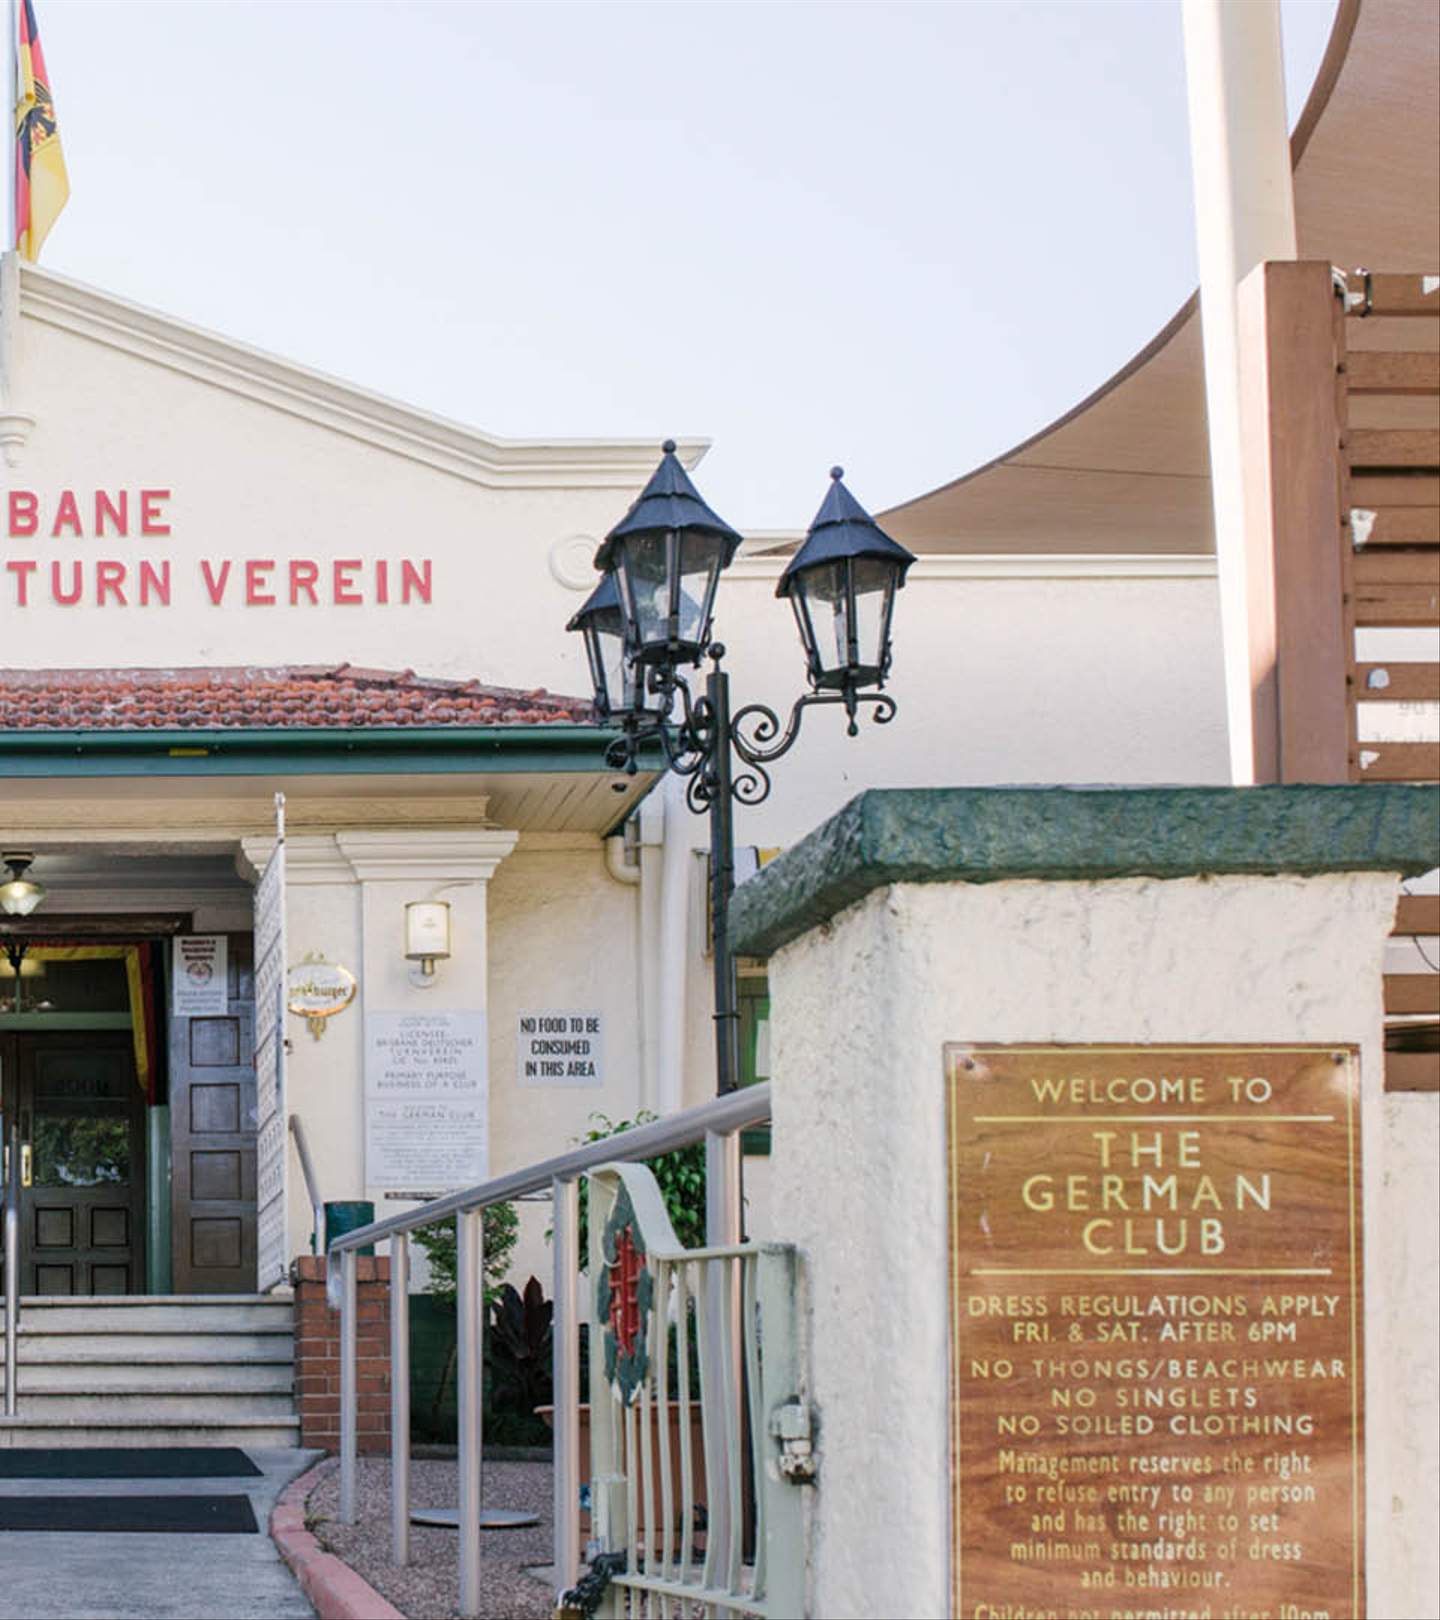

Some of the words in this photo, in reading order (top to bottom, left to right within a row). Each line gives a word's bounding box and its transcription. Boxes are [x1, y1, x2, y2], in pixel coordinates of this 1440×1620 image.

[6, 560, 171, 608] TURN
[200, 559, 433, 606] VEREIN
[520, 1017, 536, 1033] NO
[538, 1017, 567, 1033] FOOD
[569, 1017, 584, 1033] TO
[586, 1017, 600, 1033] BE
[530, 1039, 591, 1055] CONSUMED
[525, 1060, 537, 1077] IN
[540, 1060, 565, 1077] THIS
[567, 1060, 596, 1077] AREA
[1031, 1078, 1205, 1103] WELCOME
[1228, 1078, 1272, 1103] TO
[1093, 1131, 1201, 1168] THE
[1022, 1175, 1271, 1211] GERMAN
[1082, 1219, 1225, 1256] CLUB
[968, 1296, 1048, 1317] DRESS
[1061, 1295, 1247, 1317] REGULATIONS
[1261, 1295, 1340, 1317] APPLY
[1013, 1322, 1055, 1343] FRI.
[1068, 1322, 1083, 1343] &
[1096, 1322, 1148, 1343] SAT.
[1160, 1322, 1236, 1343] AFTER
[1247, 1322, 1297, 1343] 6PM
[971, 1360, 1013, 1379] NO
[1032, 1359, 1346, 1380] THONGS/BEACHWEAR
[1051, 1388, 1096, 1407] NO
[1116, 1388, 1257, 1407] SINGLETS
[997, 1416, 1040, 1435] NO
[1056, 1416, 1154, 1435] SOILED
[1169, 1416, 1314, 1435] CLOTHING
[998, 1450, 1119, 1479] Management
[1128, 1456, 1212, 1473] reserves
[1223, 1451, 1254, 1473] the
[1263, 1451, 1311, 1479] right
[1006, 1484, 1026, 1502] to
[1036, 1479, 1098, 1502] refuse
[1107, 1484, 1160, 1508] entry
[1171, 1484, 1193, 1502] to
[1204, 1486, 1235, 1508] any
[1247, 1486, 1315, 1508] person
[1031, 1508, 1065, 1532] and
[1074, 1508, 1105, 1532] has
[1117, 1508, 1148, 1532] the
[1159, 1509, 1206, 1538] right
[1218, 1512, 1238, 1531] to
[1249, 1512, 1279, 1531] set
[1011, 1539, 1101, 1560] minimum
[1110, 1537, 1206, 1560] standards
[1218, 1537, 1236, 1560] of
[1248, 1537, 1302, 1560] dress
[1080, 1565, 1115, 1587] and
[1125, 1564, 1231, 1587] behaviour.
